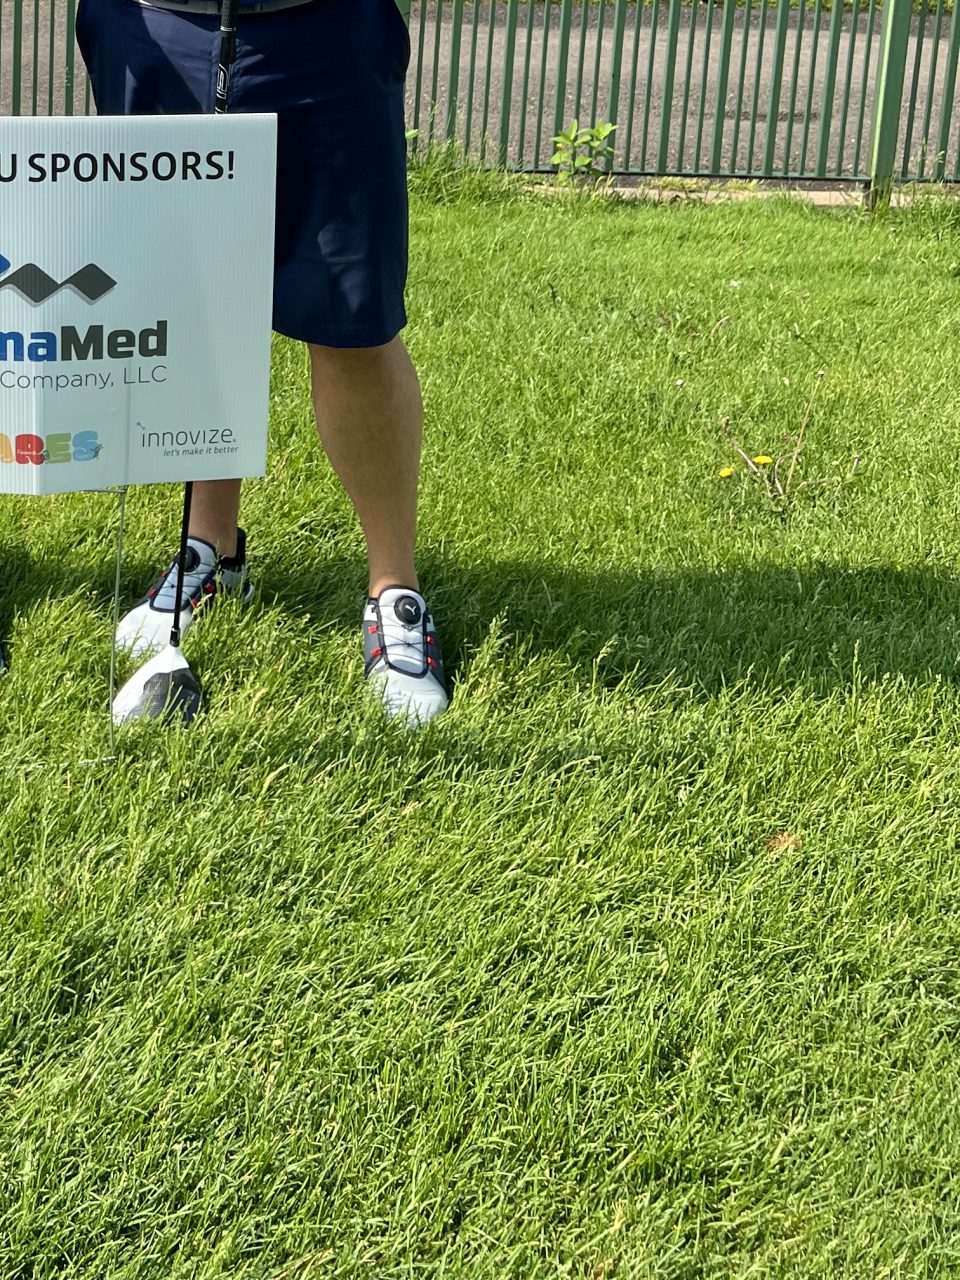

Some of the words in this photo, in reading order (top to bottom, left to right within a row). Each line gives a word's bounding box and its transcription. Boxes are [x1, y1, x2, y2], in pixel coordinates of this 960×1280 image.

[28, 150, 234, 183] SPONSORS!
[0, 370, 115, 391] Company,
[123, 365, 167, 385] LLC
[214, 446, 239, 454] better
